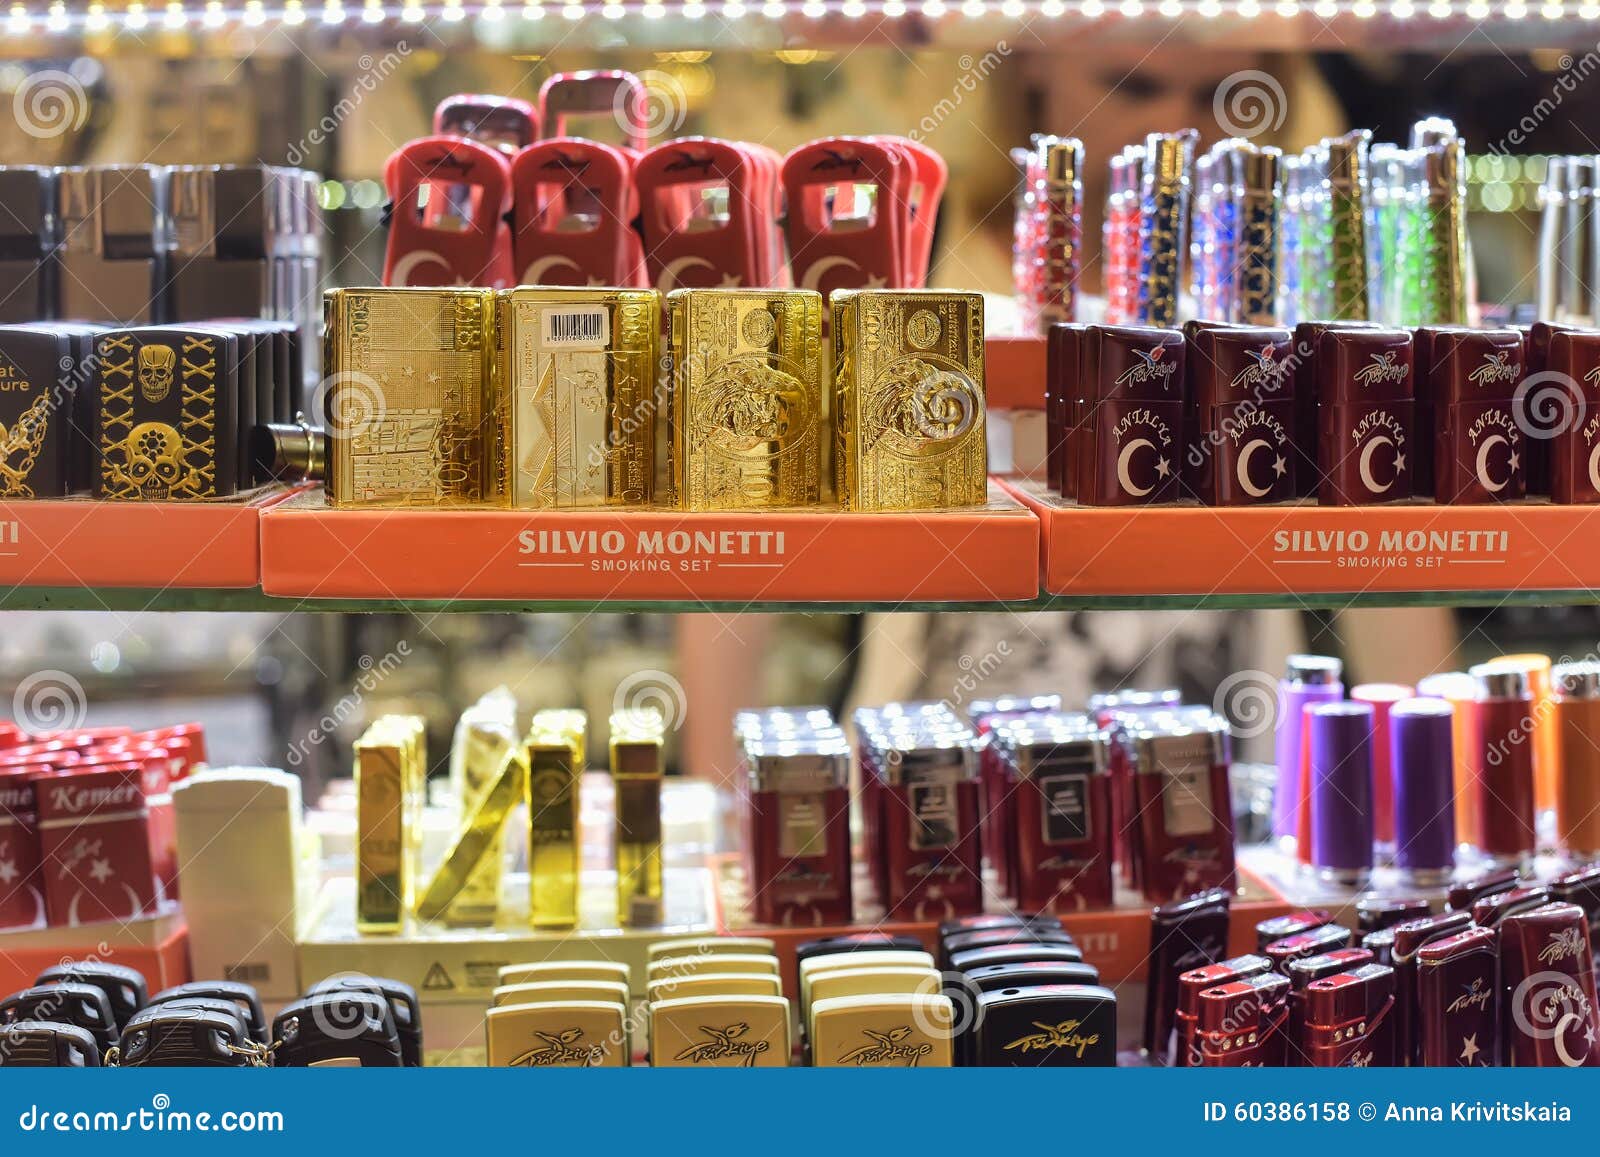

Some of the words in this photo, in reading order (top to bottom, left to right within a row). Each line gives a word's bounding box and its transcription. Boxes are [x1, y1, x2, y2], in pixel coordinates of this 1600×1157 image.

[1113, 408, 1172, 447] ANTALYA
[518, 530, 626, 555] SILVIO
[636, 531, 785, 555] MONETTI
[1273, 530, 1370, 553] SILVIO
[1378, 530, 1509, 552] MONETTI
[590, 559, 671, 572] SMOKING
[679, 560, 713, 572] SET
[1336, 556, 1409, 568] SMOKING
[1415, 556, 1445, 568] SET
